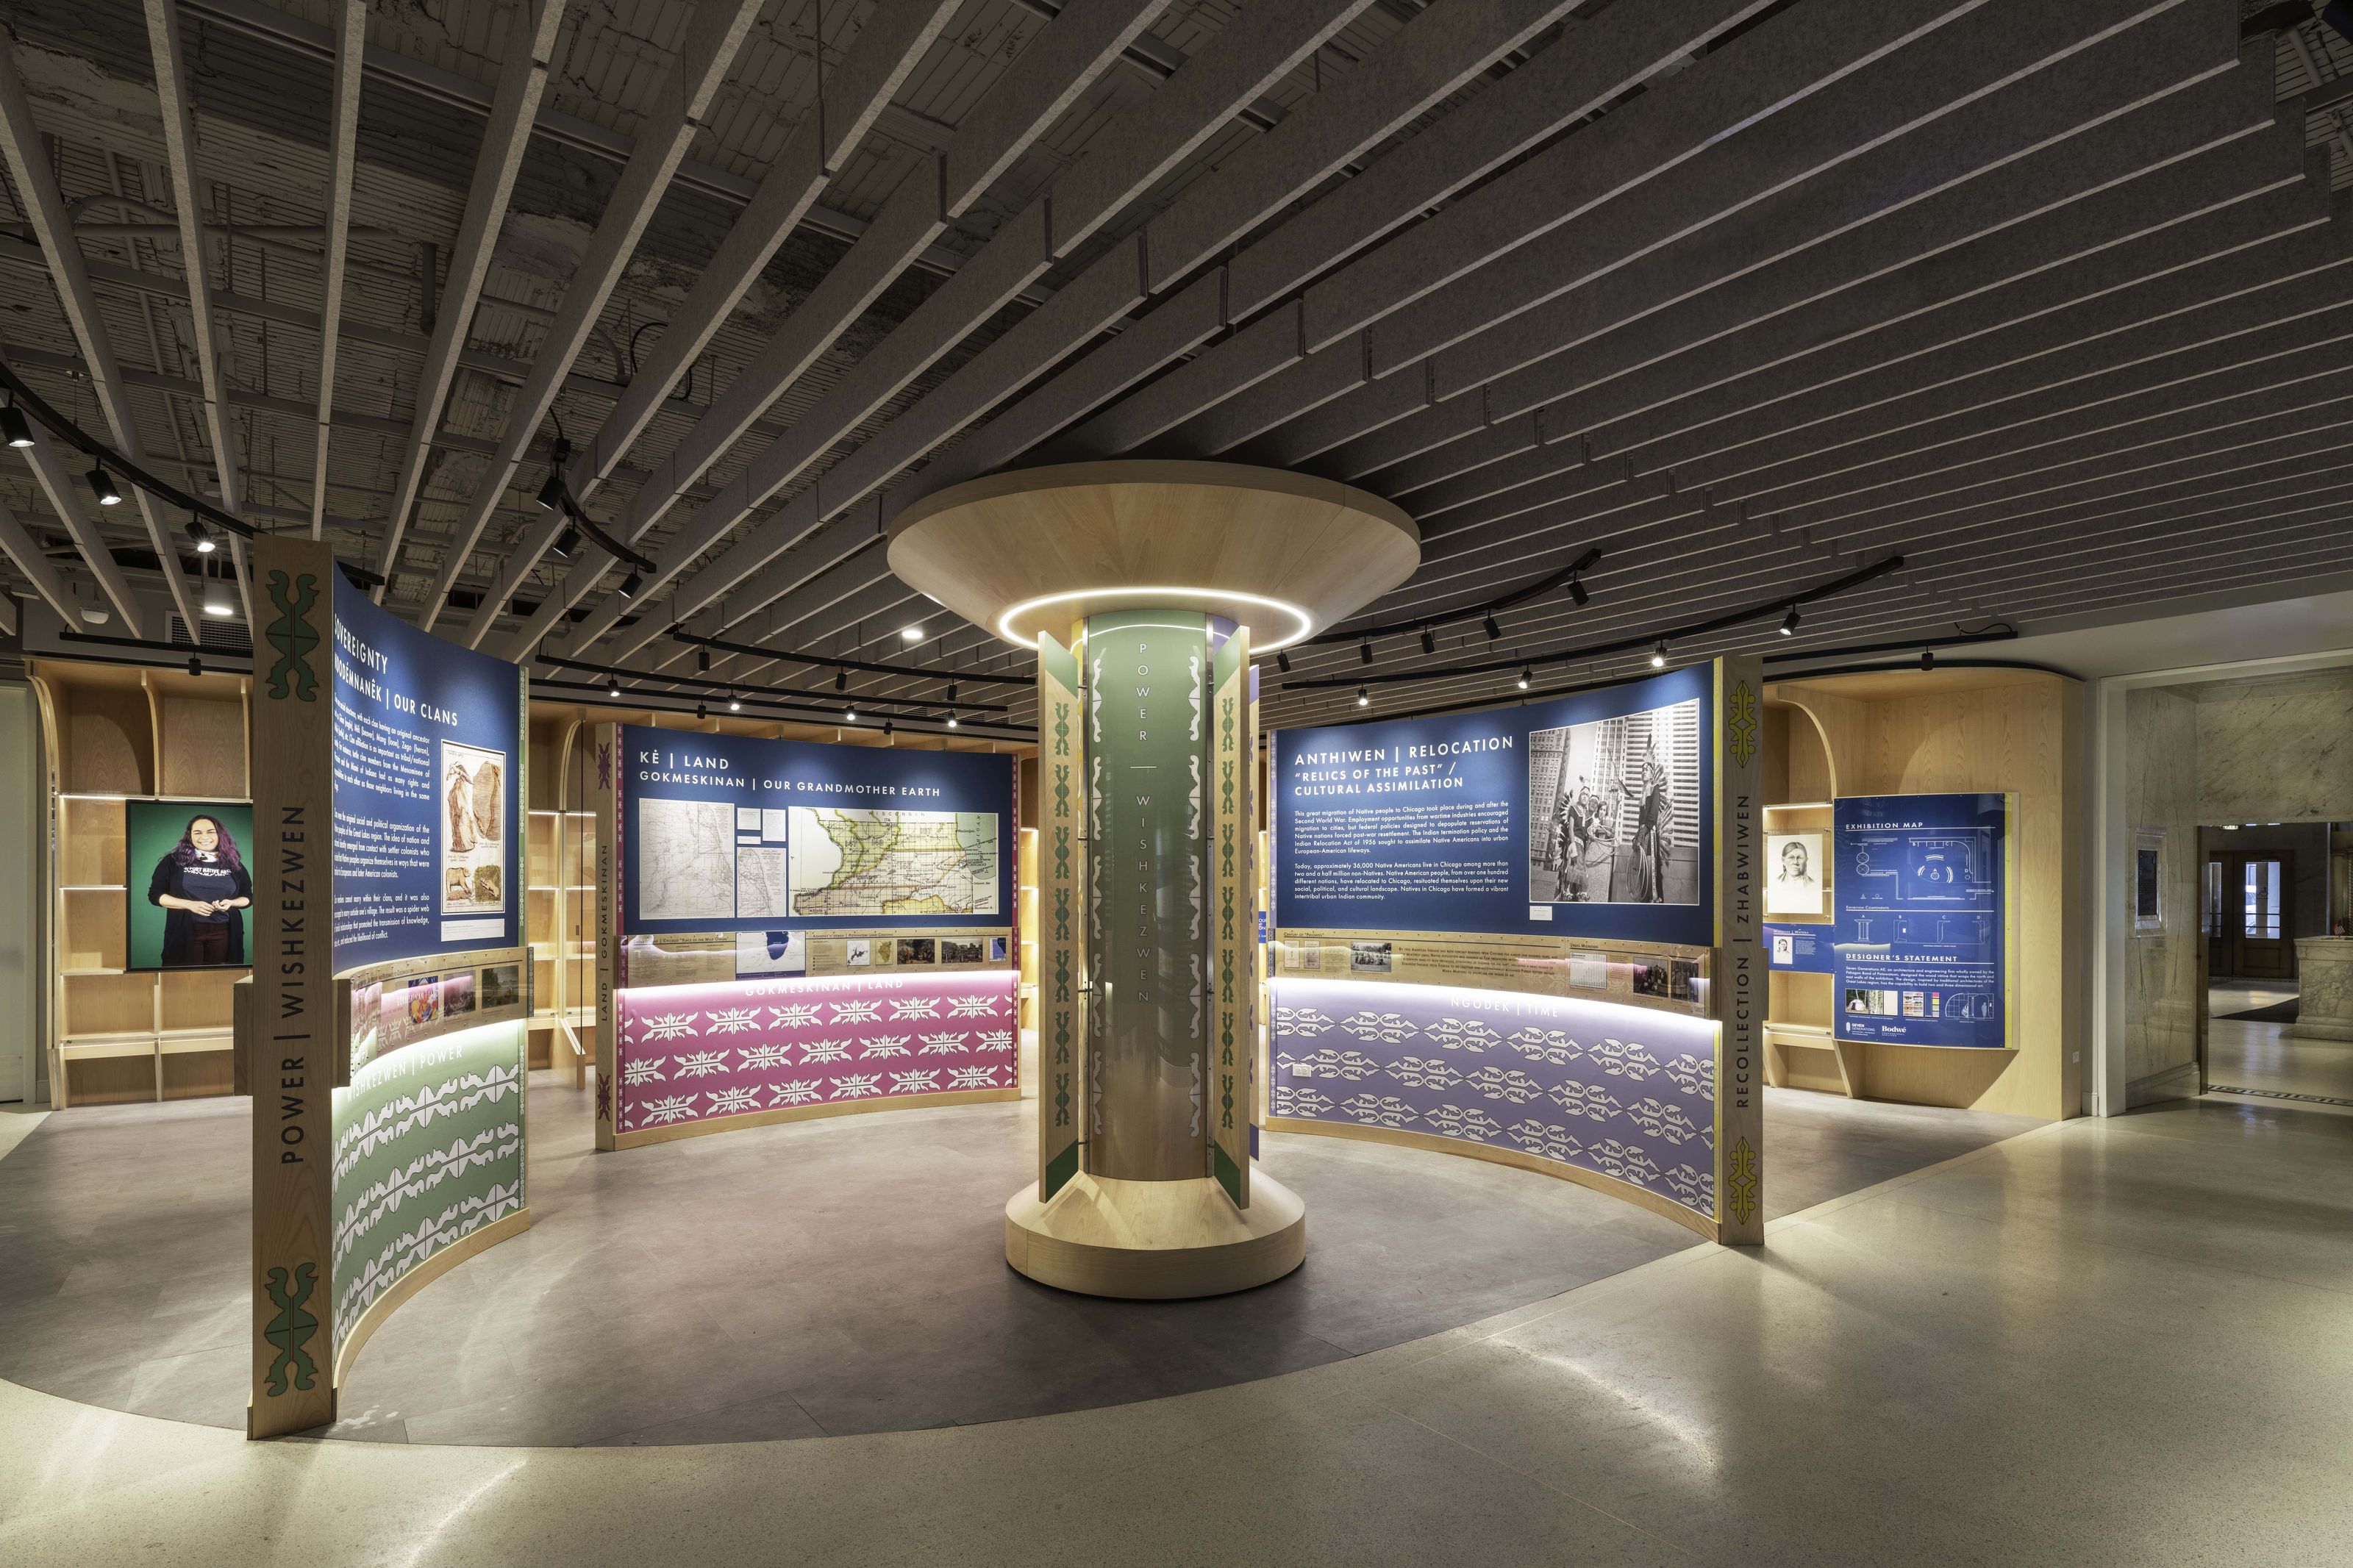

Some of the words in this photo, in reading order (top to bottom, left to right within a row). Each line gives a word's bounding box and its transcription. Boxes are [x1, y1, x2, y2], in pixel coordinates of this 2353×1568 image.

[335, 613, 388, 674] SOVEREIGNTY
[1136, 643, 1150, 740] POWER
[394, 694, 415, 715] OUR
[421, 704, 457, 726] CLANS
[379, 720, 390, 734] having
[397, 729, 412, 739] original
[413, 735, 430, 743] ancestor
[685, 755, 729, 770] LAND
[1295, 748, 1385, 765] ANTHIWEN
[1409, 735, 1513, 759] RELOCATION
[640, 771, 745, 787] GOKMESKINAN
[763, 780, 790, 790] OUR
[797, 781, 896, 795] GRANDMOTHER
[901, 787, 940, 797] EARTH
[1295, 783, 1360, 796] CULTURAL
[1366, 777, 1463, 792] ASSIMILATION
[1352, 768, 1370, 779] OF
[1375, 767, 1399, 777] THE
[374, 818, 388, 829] political
[390, 823, 414, 832] organization
[416, 824, 421, 833] of
[1382, 814, 1415, 822] opportunities
[1737, 795, 1749, 924] ZHABWIWEN
[282, 807, 304, 1018] WISHKEZWEN
[385, 905, 395, 913] result
[407, 904, 420, 914] spider
[421, 904, 429, 912] web
[1136, 795, 1151, 1002] WISHKEZWEN
[746, 982, 851, 996] GOKMESKINAN
[868, 980, 903, 989] LAND
[1451, 997, 1509, 1012] NGODEK
[1527, 1004, 1558, 1017] TIME
[1737, 957, 1749, 1108] RECOLLECTION
[346, 1064, 406, 1103] WISHKEZWEN
[421, 1045, 463, 1069] POWER
[282, 1057, 304, 1164] POWER
